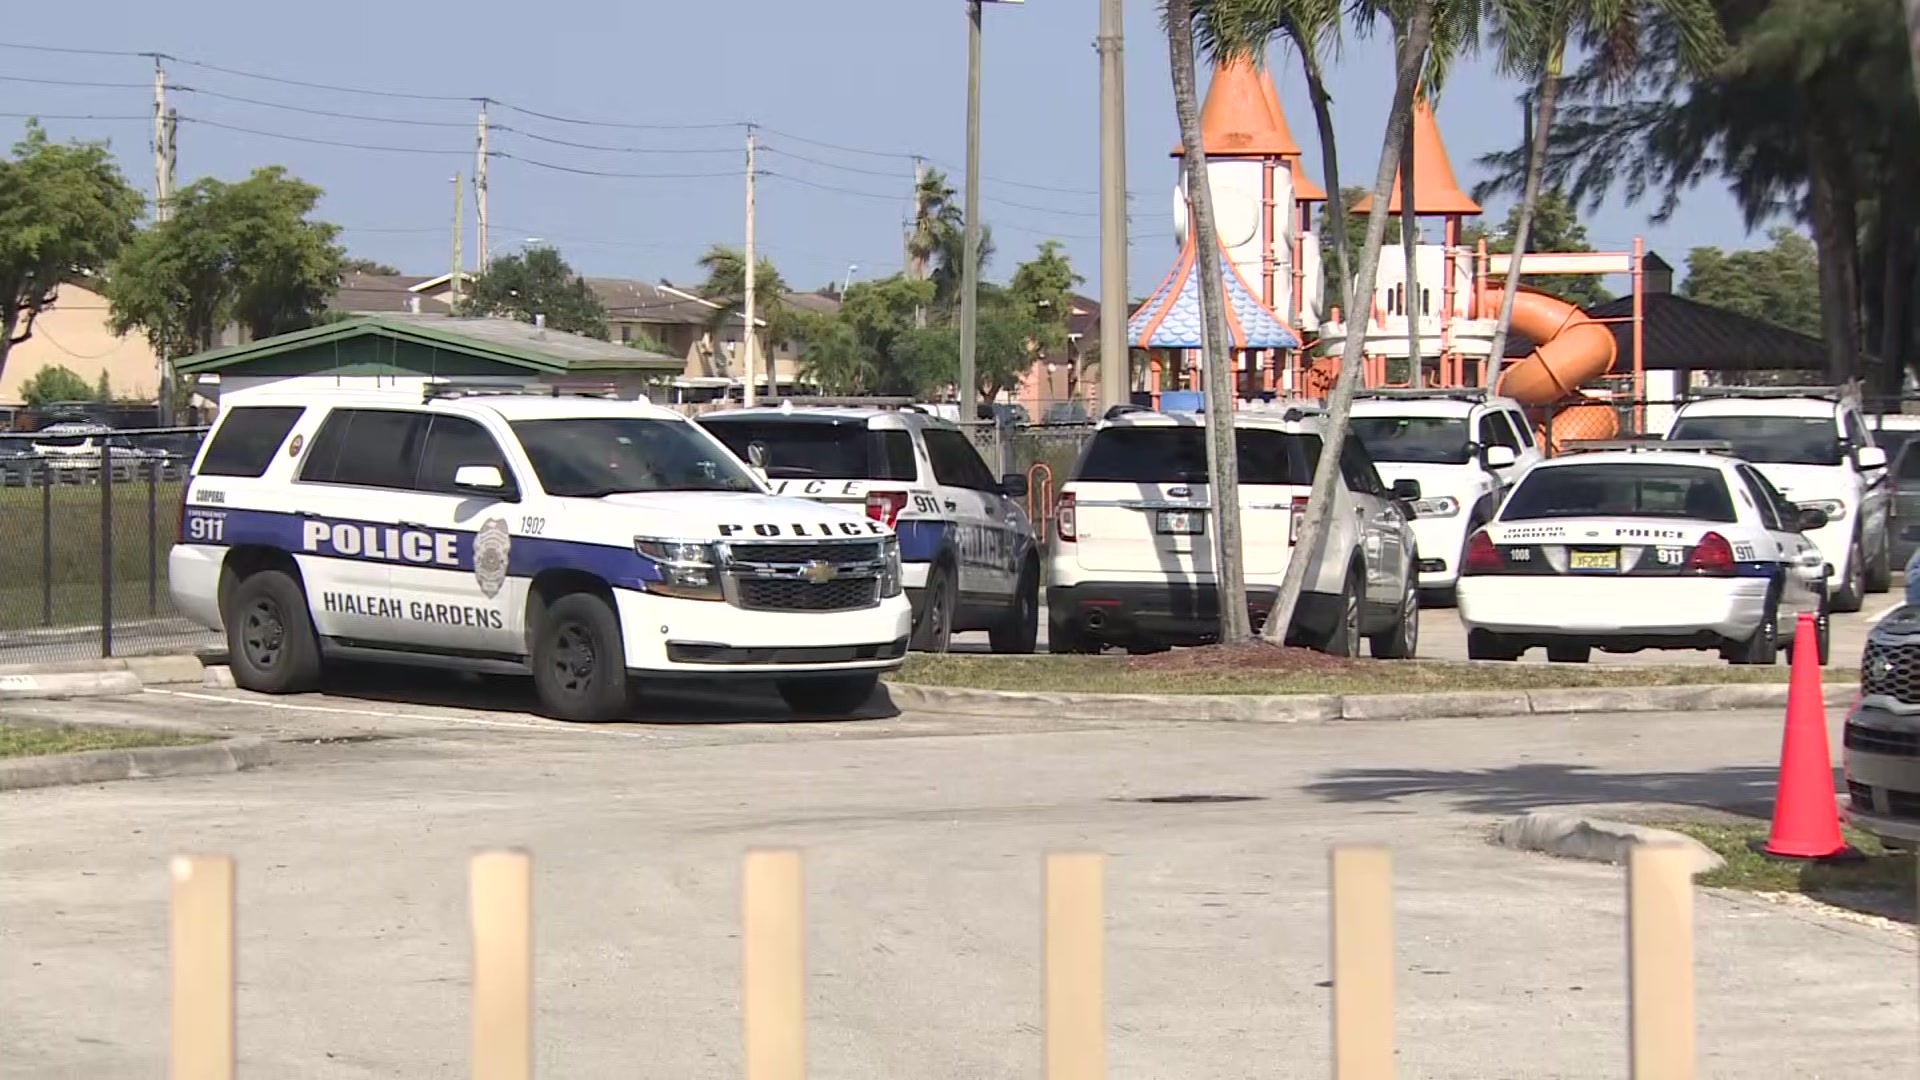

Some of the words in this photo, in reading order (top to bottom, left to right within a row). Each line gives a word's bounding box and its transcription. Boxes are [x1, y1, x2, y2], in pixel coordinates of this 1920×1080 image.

[196, 489, 226, 503] CORPORAL
[766, 480, 864, 496] ICE
[914, 495, 941, 514] 911
[190, 517, 223, 540] 911
[521, 516, 545, 535] 1902
[718, 522, 886, 537] POLICE
[1615, 528, 1686, 539] POLICE
[303, 520, 460, 565] POLICE
[1658, 549, 1684, 565] 911
[1735, 545, 1756, 560] 911
[323, 591, 403, 619] HIALEAH
[411, 601, 503, 629] GARDENS
